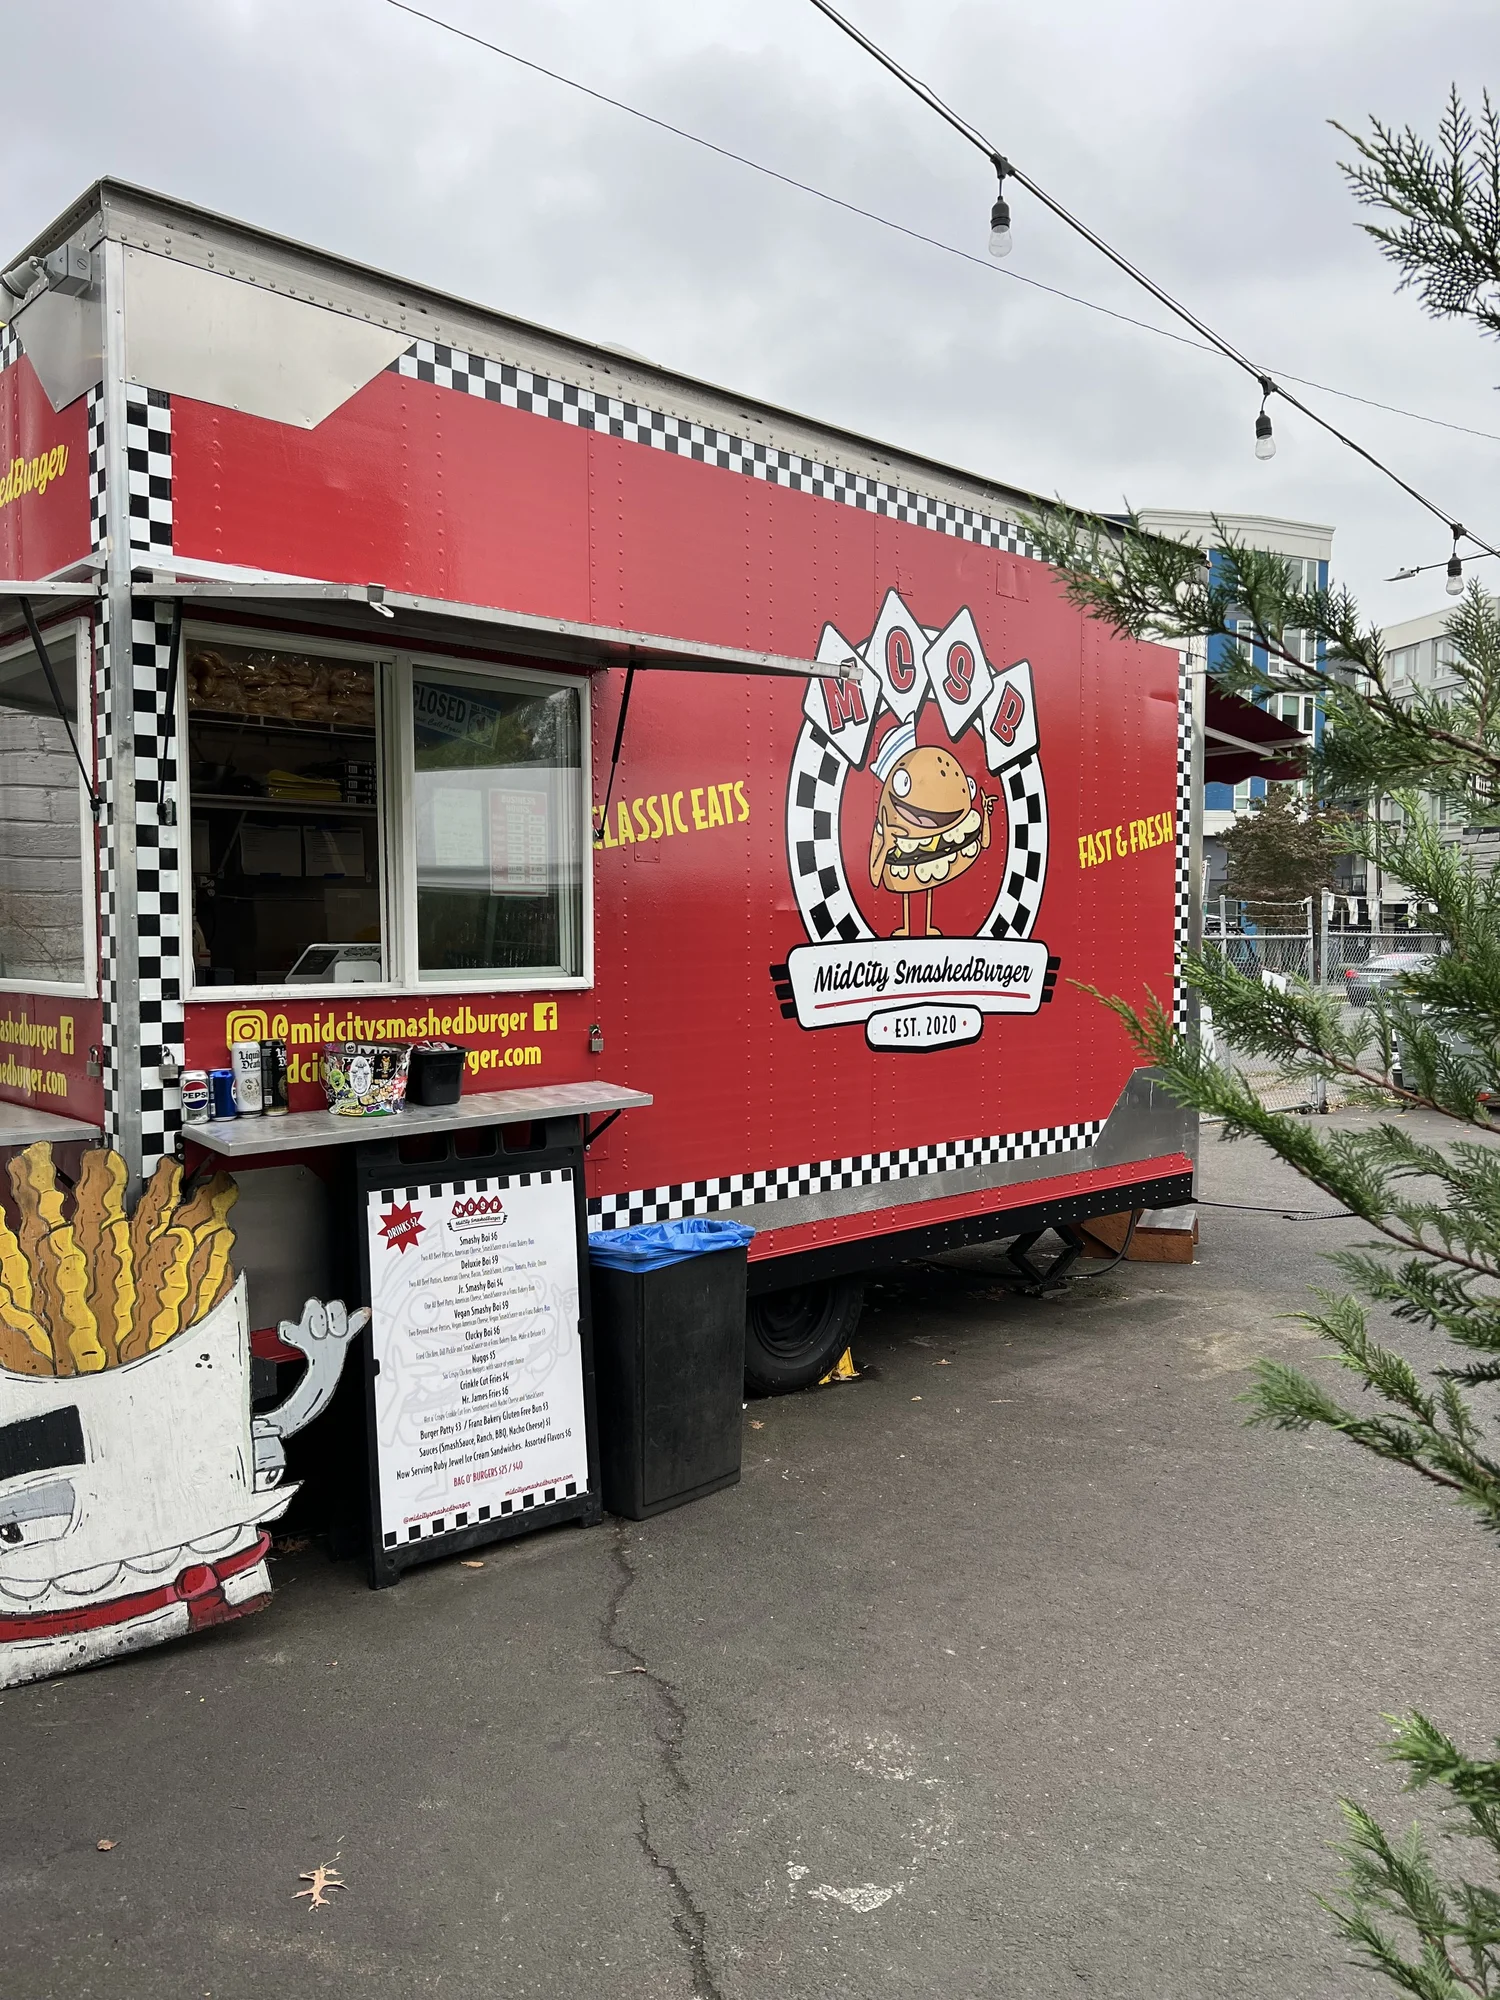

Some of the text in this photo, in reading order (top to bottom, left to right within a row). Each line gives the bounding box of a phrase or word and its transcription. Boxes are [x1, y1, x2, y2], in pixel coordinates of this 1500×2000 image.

[690, 780, 750, 830] EATS
[1078, 811, 1174, 869] FAST & FRESH
[814, 955, 1034, 993] MidCity SmashedBurger
[895, 1014, 957, 1038] EST. 2020
[387, 1217, 419, 1240] DRINKS $2
[459, 1231, 497, 1245] Smashy Boi $6
[481, 1256, 491, 1266] Boi
[491, 1254, 498, 1264] $9
[465, 1281, 486, 1292] Smashy
[486, 1279, 496, 1289] Boi
[496, 1278, 503, 1286] $4
[453, 1300, 508, 1319] Vegan Smashy Boi $9
[465, 1325, 500, 1340] Clucky Boi $6
[471, 1350, 495, 1364] Nuggs $5
[459, 1371, 509, 1390] Crinkle Cut Fries $4
[461, 1385, 508, 1404] Mr. James Fries $6
[420, 1401, 548, 1440] Burger Patty $3 / Franz Bakery Gluten Free Bun $3
[418, 1446, 438, 1457] Sauces
[476, 1431, 494, 1443] Ranch,
[495, 1427, 508, 1439] BBQ,
[508, 1424, 525, 1435] Nacho
[525, 1418, 545, 1431] Cheese)
[545, 1416, 550, 1426] $1
[396, 1470, 410, 1480] Now
[410, 1464, 432, 1476] Serving
[433, 1460, 447, 1470] Ruby
[448, 1454, 464, 1467] Jewel
[473, 1451, 489, 1460] Cream
[524, 1434, 546, 1447] Assorted
[546, 1432, 564, 1442] Flavors
[564, 1427, 571, 1437] $6
[453, 1475, 465, 1486] BAG
[472, 1466, 498, 1482] BURGERS
[498, 1464, 507, 1474] $25
[508, 1463, 512, 1472] /
[512, 1460, 523, 1471] $40
